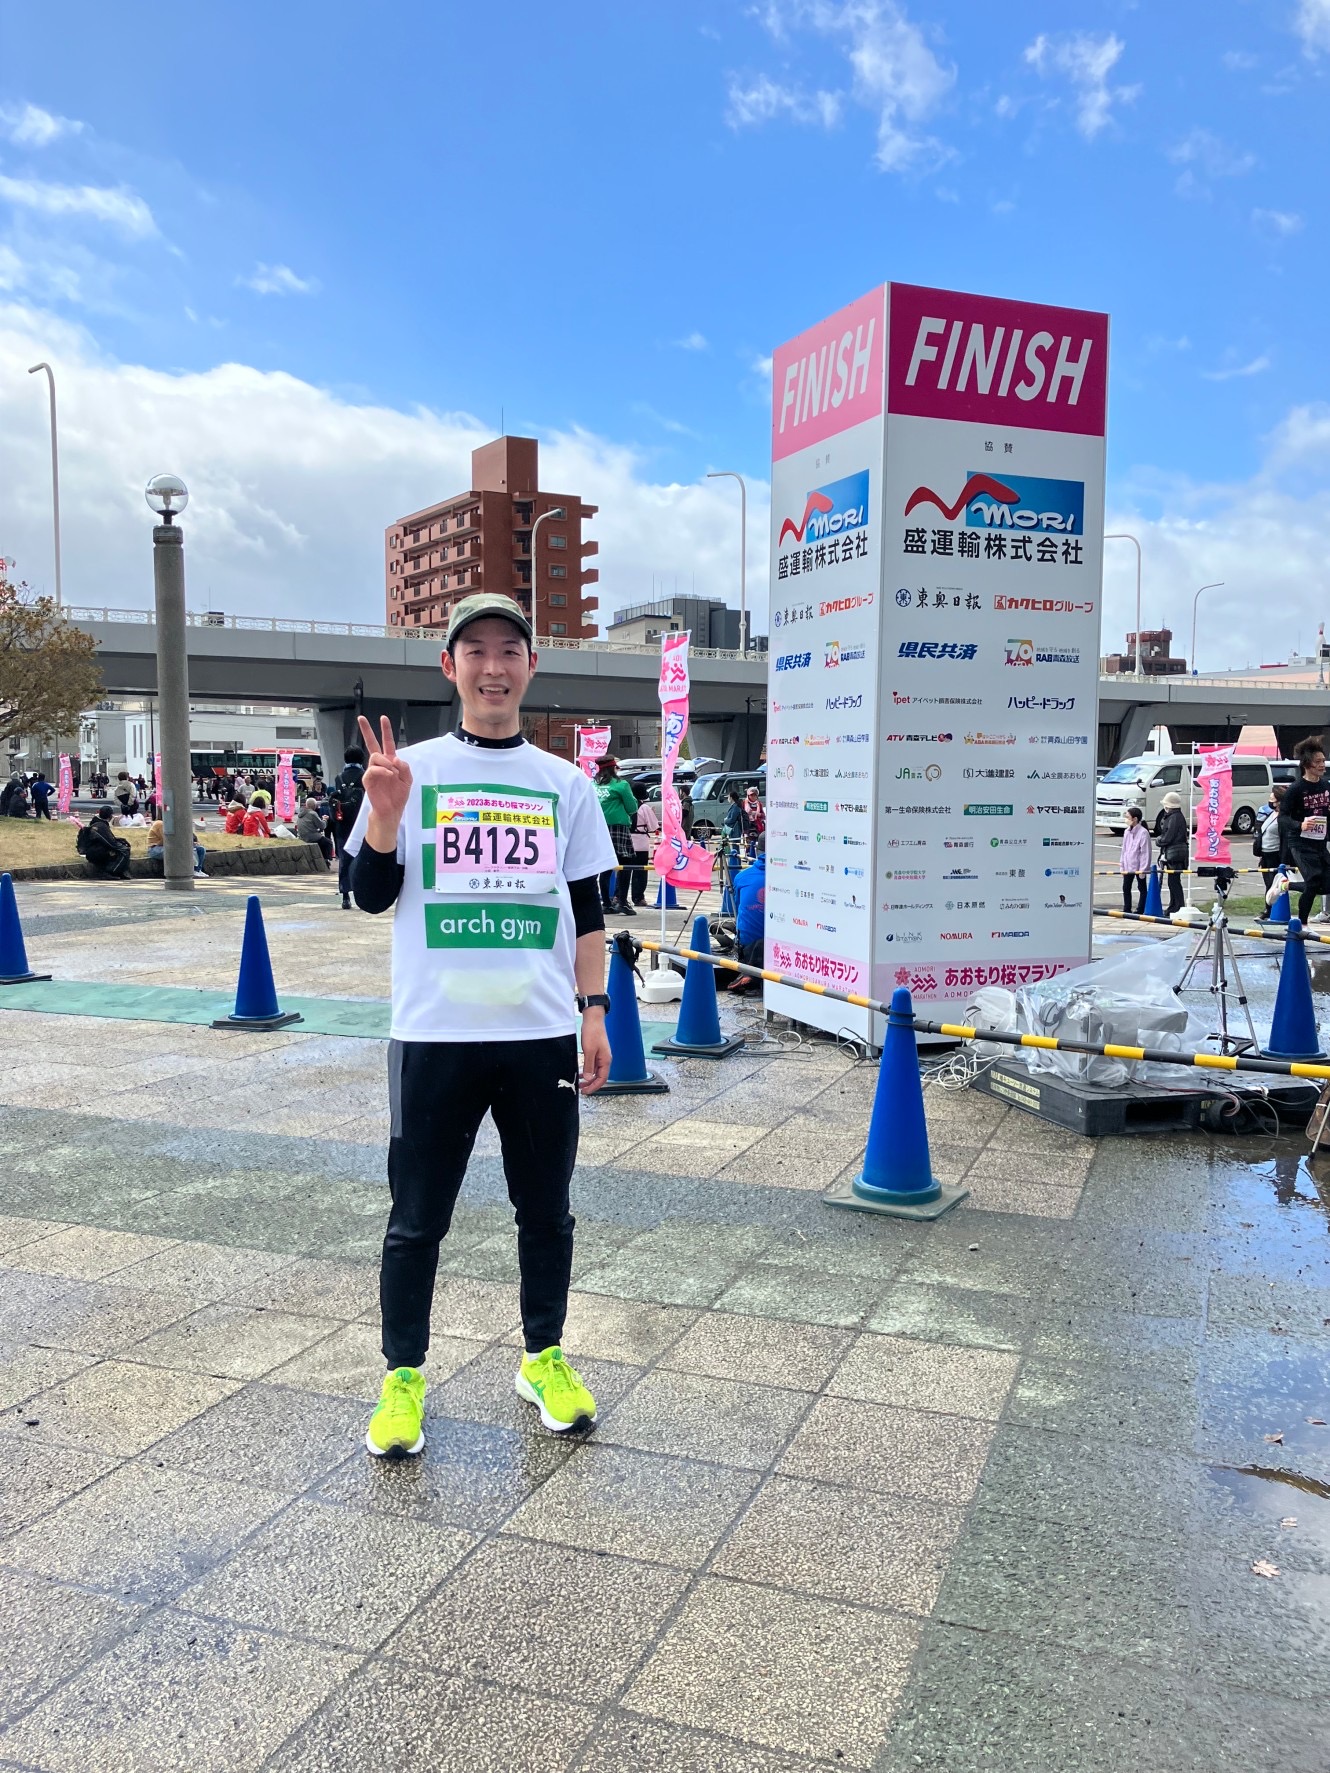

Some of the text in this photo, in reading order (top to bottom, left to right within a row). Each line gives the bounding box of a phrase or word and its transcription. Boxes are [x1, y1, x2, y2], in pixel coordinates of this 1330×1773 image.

[905, 315, 1093, 406] FINISH
[779, 317, 876, 434] FINISH
[970, 501, 1075, 531] MORI
[778, 531, 869, 580] 盛運輸株式会社
[903, 527, 1084, 566] 盛運輸株式会社
[915, 586, 982, 611] 東奥日報
[1007, 597, 1094, 614] カクヒログループ
[897, 641, 979, 660] 県民共済
[775, 652, 812, 672] 県民共済
[886, 734, 905, 742] ATV
[975, 768, 1015, 778] 大進建設
[466, 798, 544, 812] 2023あおもり桜マラソン
[885, 805, 952, 815] 第一生命保険株式会社
[968, 805, 1011, 815] 明治安田生命
[482, 812, 551, 826] 盛運輸株式会社
[443, 826, 540, 866] B4125
[440, 909, 542, 941] arch gym
[940, 932, 973, 941] NOMURA
[794, 950, 859, 984] あおもり桜マラソン
